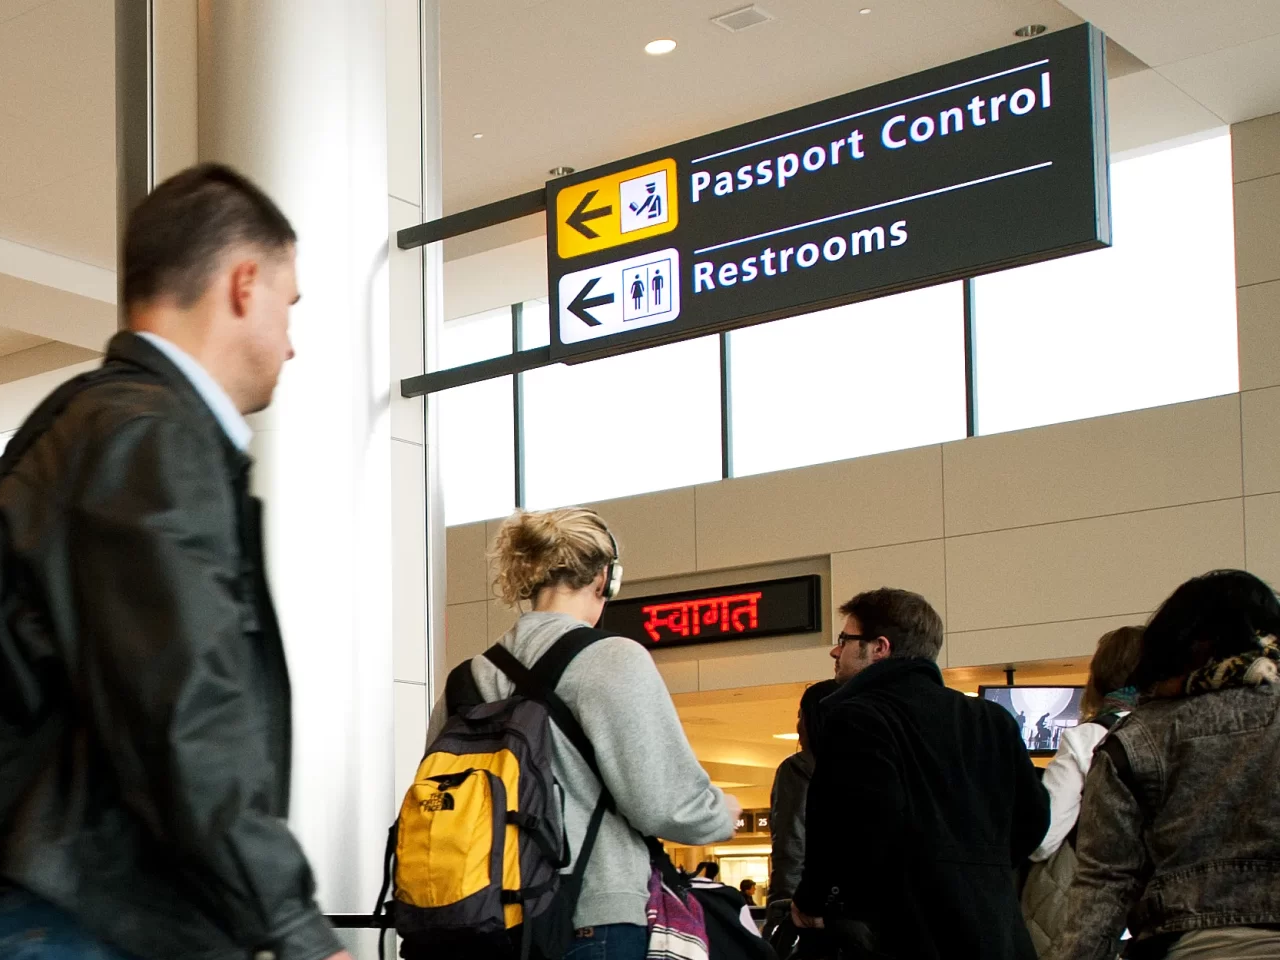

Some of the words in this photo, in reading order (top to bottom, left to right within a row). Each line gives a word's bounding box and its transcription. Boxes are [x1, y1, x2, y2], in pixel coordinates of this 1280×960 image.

[691, 130, 865, 203] Passport
[881, 72, 1052, 150] Control
[694, 219, 908, 293] Restrooms
[642, 591, 762, 642] स्वागत
